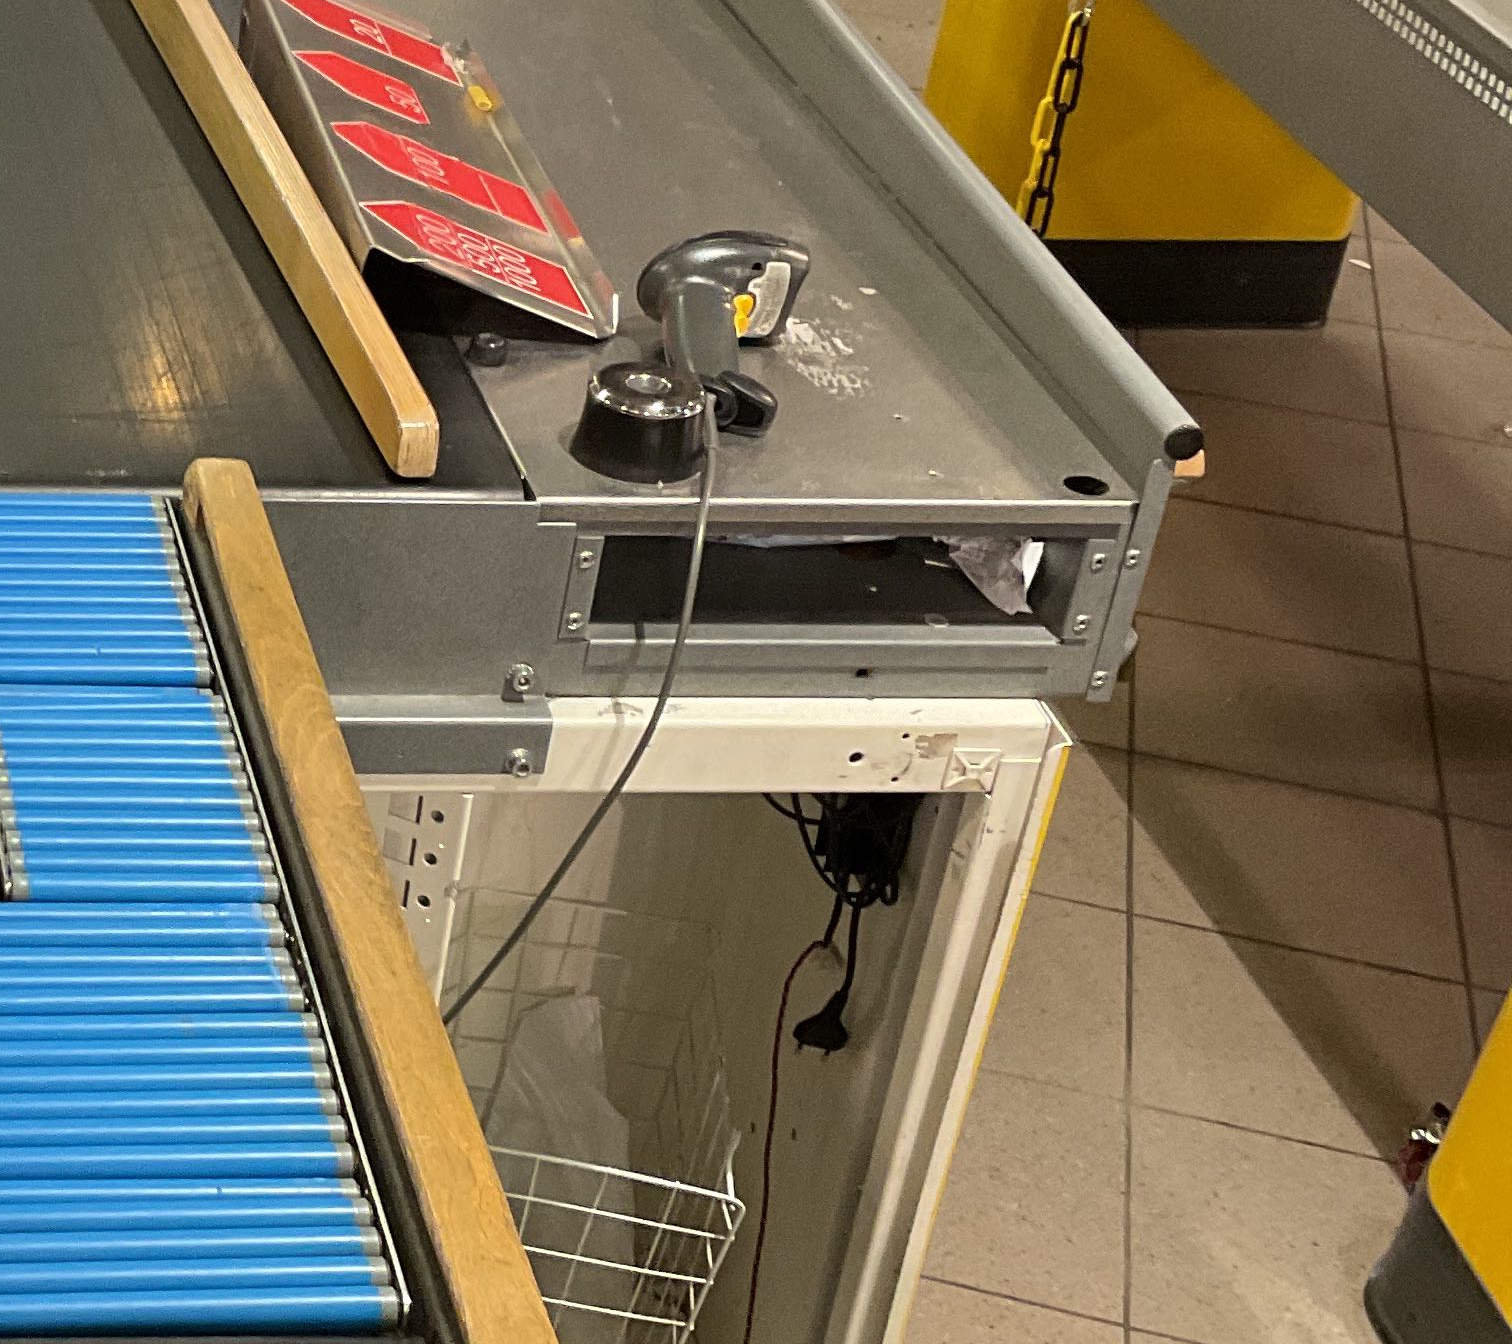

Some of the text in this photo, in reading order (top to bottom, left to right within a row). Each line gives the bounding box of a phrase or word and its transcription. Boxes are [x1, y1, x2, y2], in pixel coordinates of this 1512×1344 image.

[406, 145, 450, 186] 100
[415, 214, 465, 260] 200
[456, 232, 501, 274] 500
[492, 244, 542, 293] 1000
